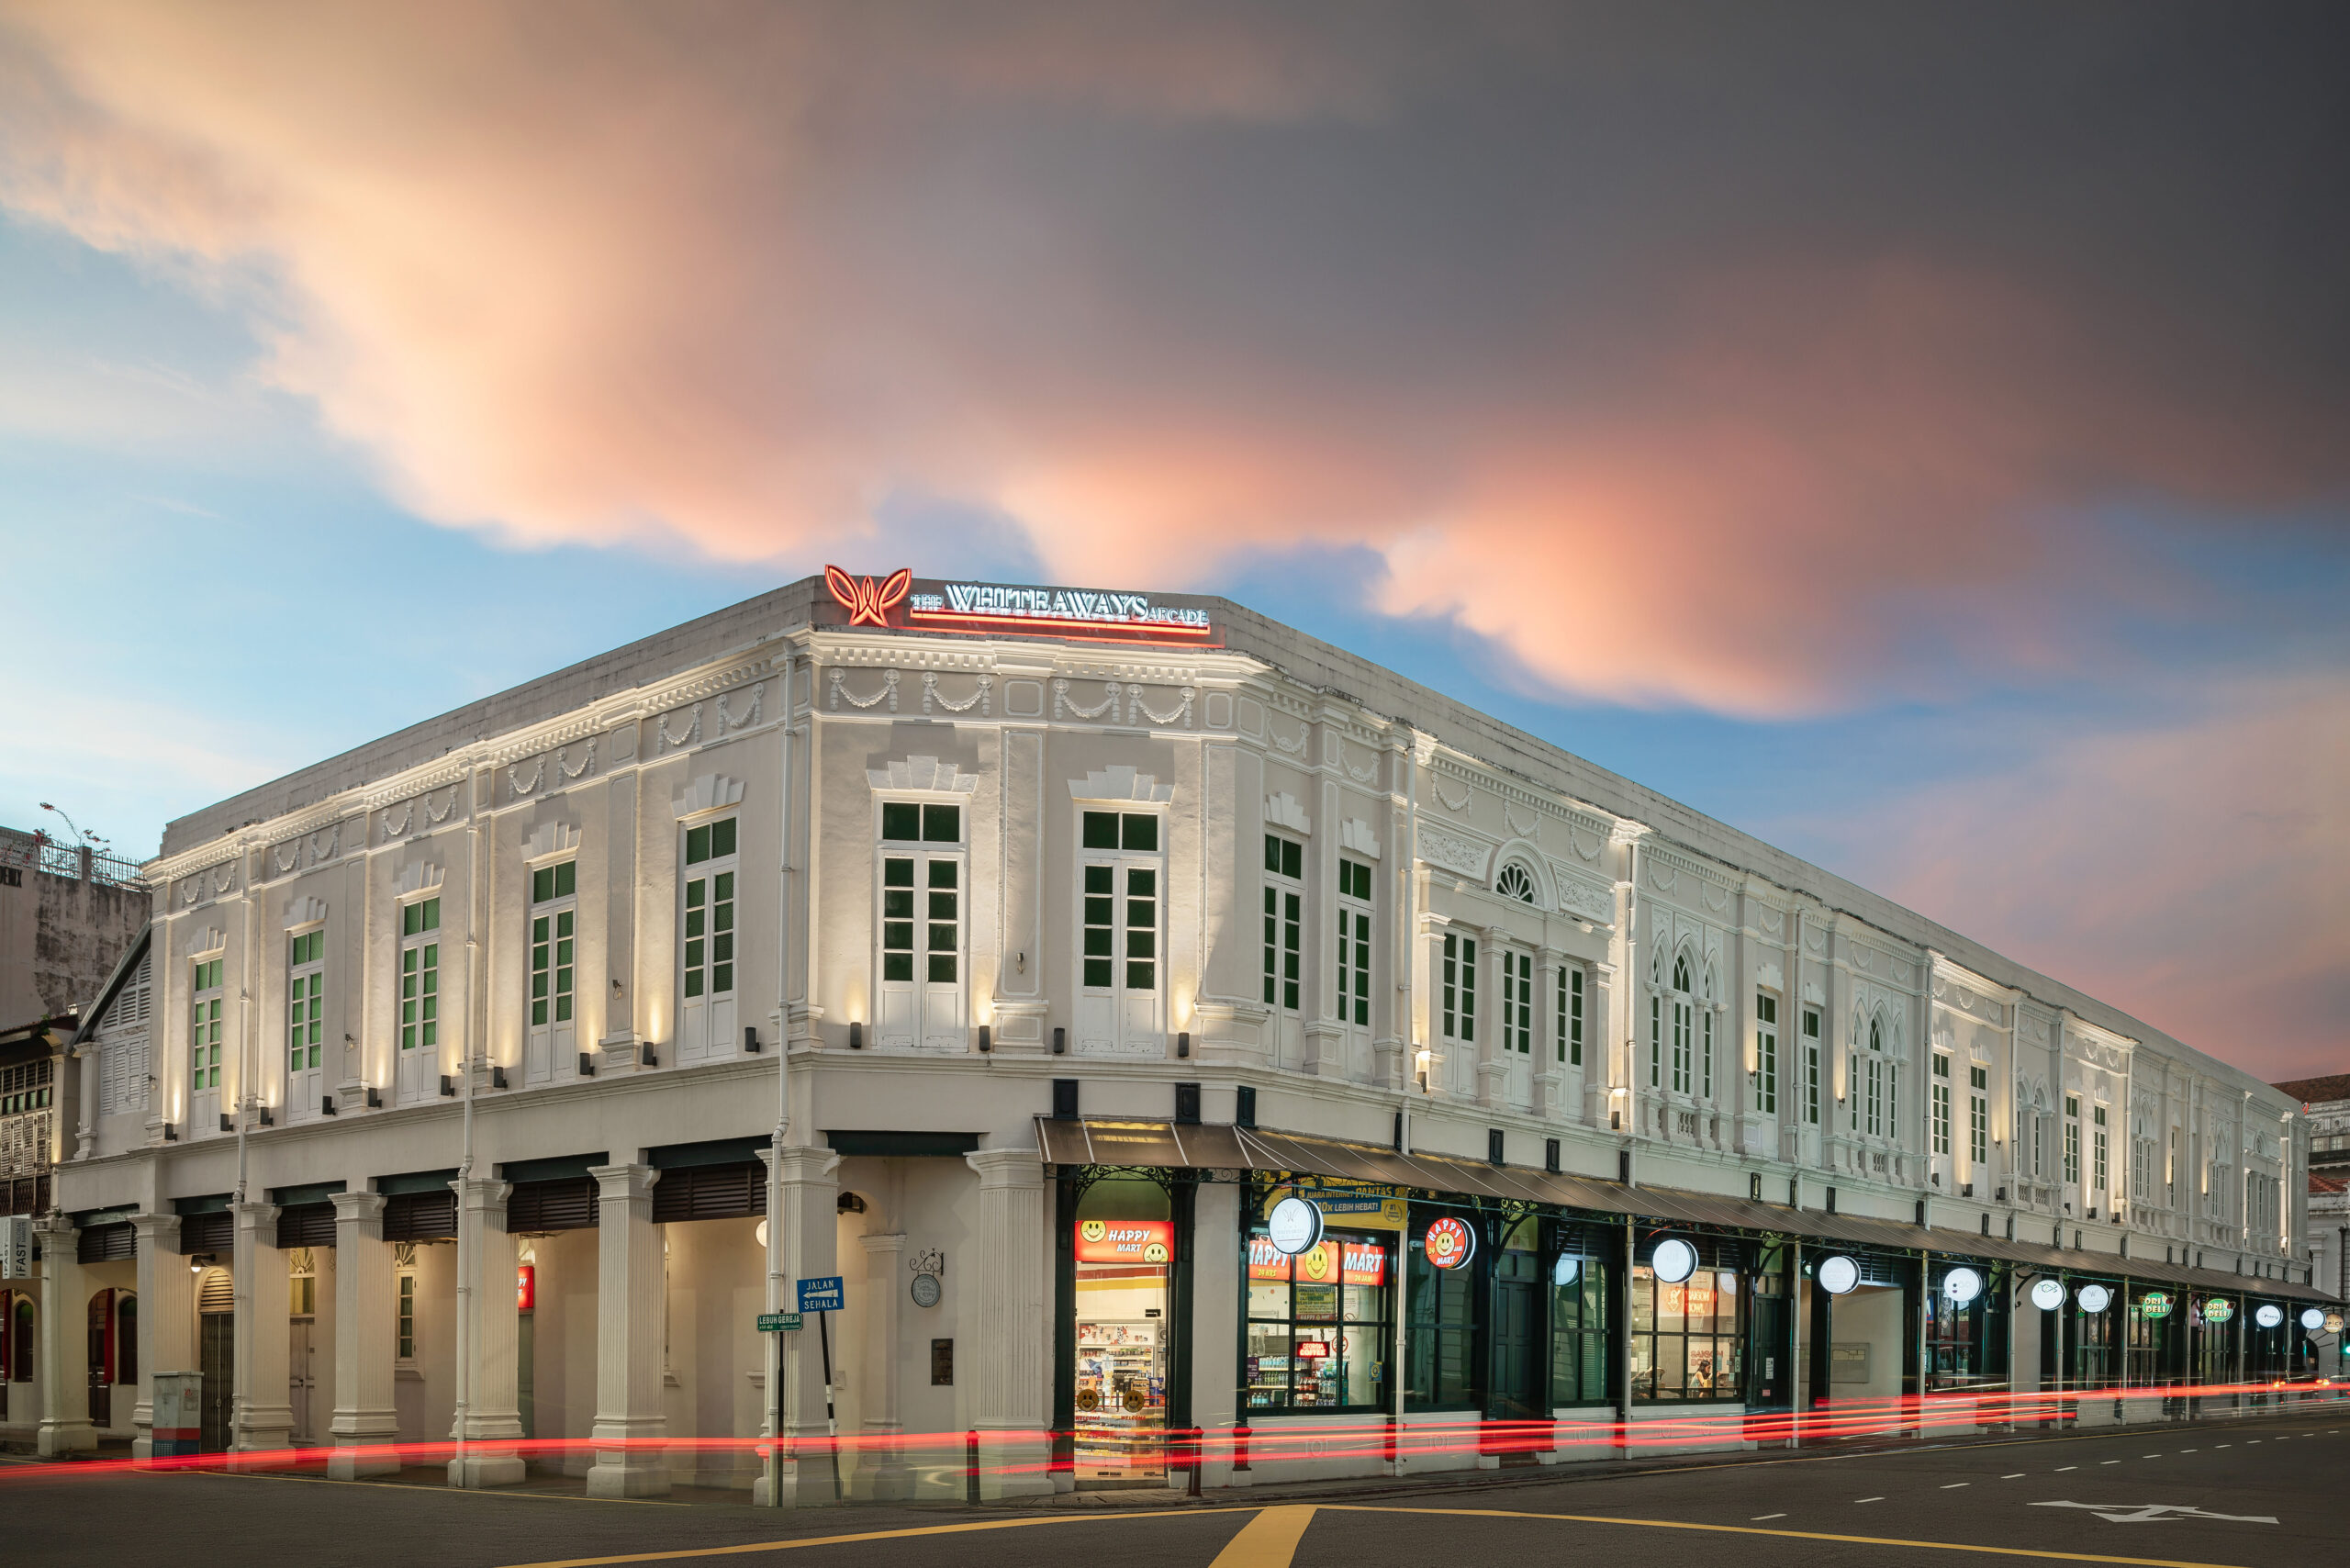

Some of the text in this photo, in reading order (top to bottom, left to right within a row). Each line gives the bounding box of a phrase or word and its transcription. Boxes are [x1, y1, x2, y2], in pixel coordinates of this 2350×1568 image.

[910, 594, 944, 609] THE
[1147, 607, 1210, 625] ARCADE
[1306, 1191, 1325, 1199] JUARA
[1355, 1186, 1393, 1198] PANTAS
[1335, 1203, 1354, 1212] LEBIH
[1355, 1202, 1379, 1211] HEBAT!
[1108, 1230, 1150, 1241] HAPPY
[1427, 1219, 1462, 1242] HAPPY
[1117, 1244, 1141, 1252] MART
[16, 1243, 27, 1277] iFAST
[1344, 1251, 1384, 1273] MART
[1436, 1255, 1456, 1266] MART
[807, 1281, 834, 1290] JALAN
[1688, 1290, 1709, 1301] AIGON
[804, 1299, 837, 1309] SEHALA
[1688, 1303, 1706, 1314] OWL
[2145, 1305, 2166, 1314] DELI
[759, 1316, 778, 1325] LEBUH
